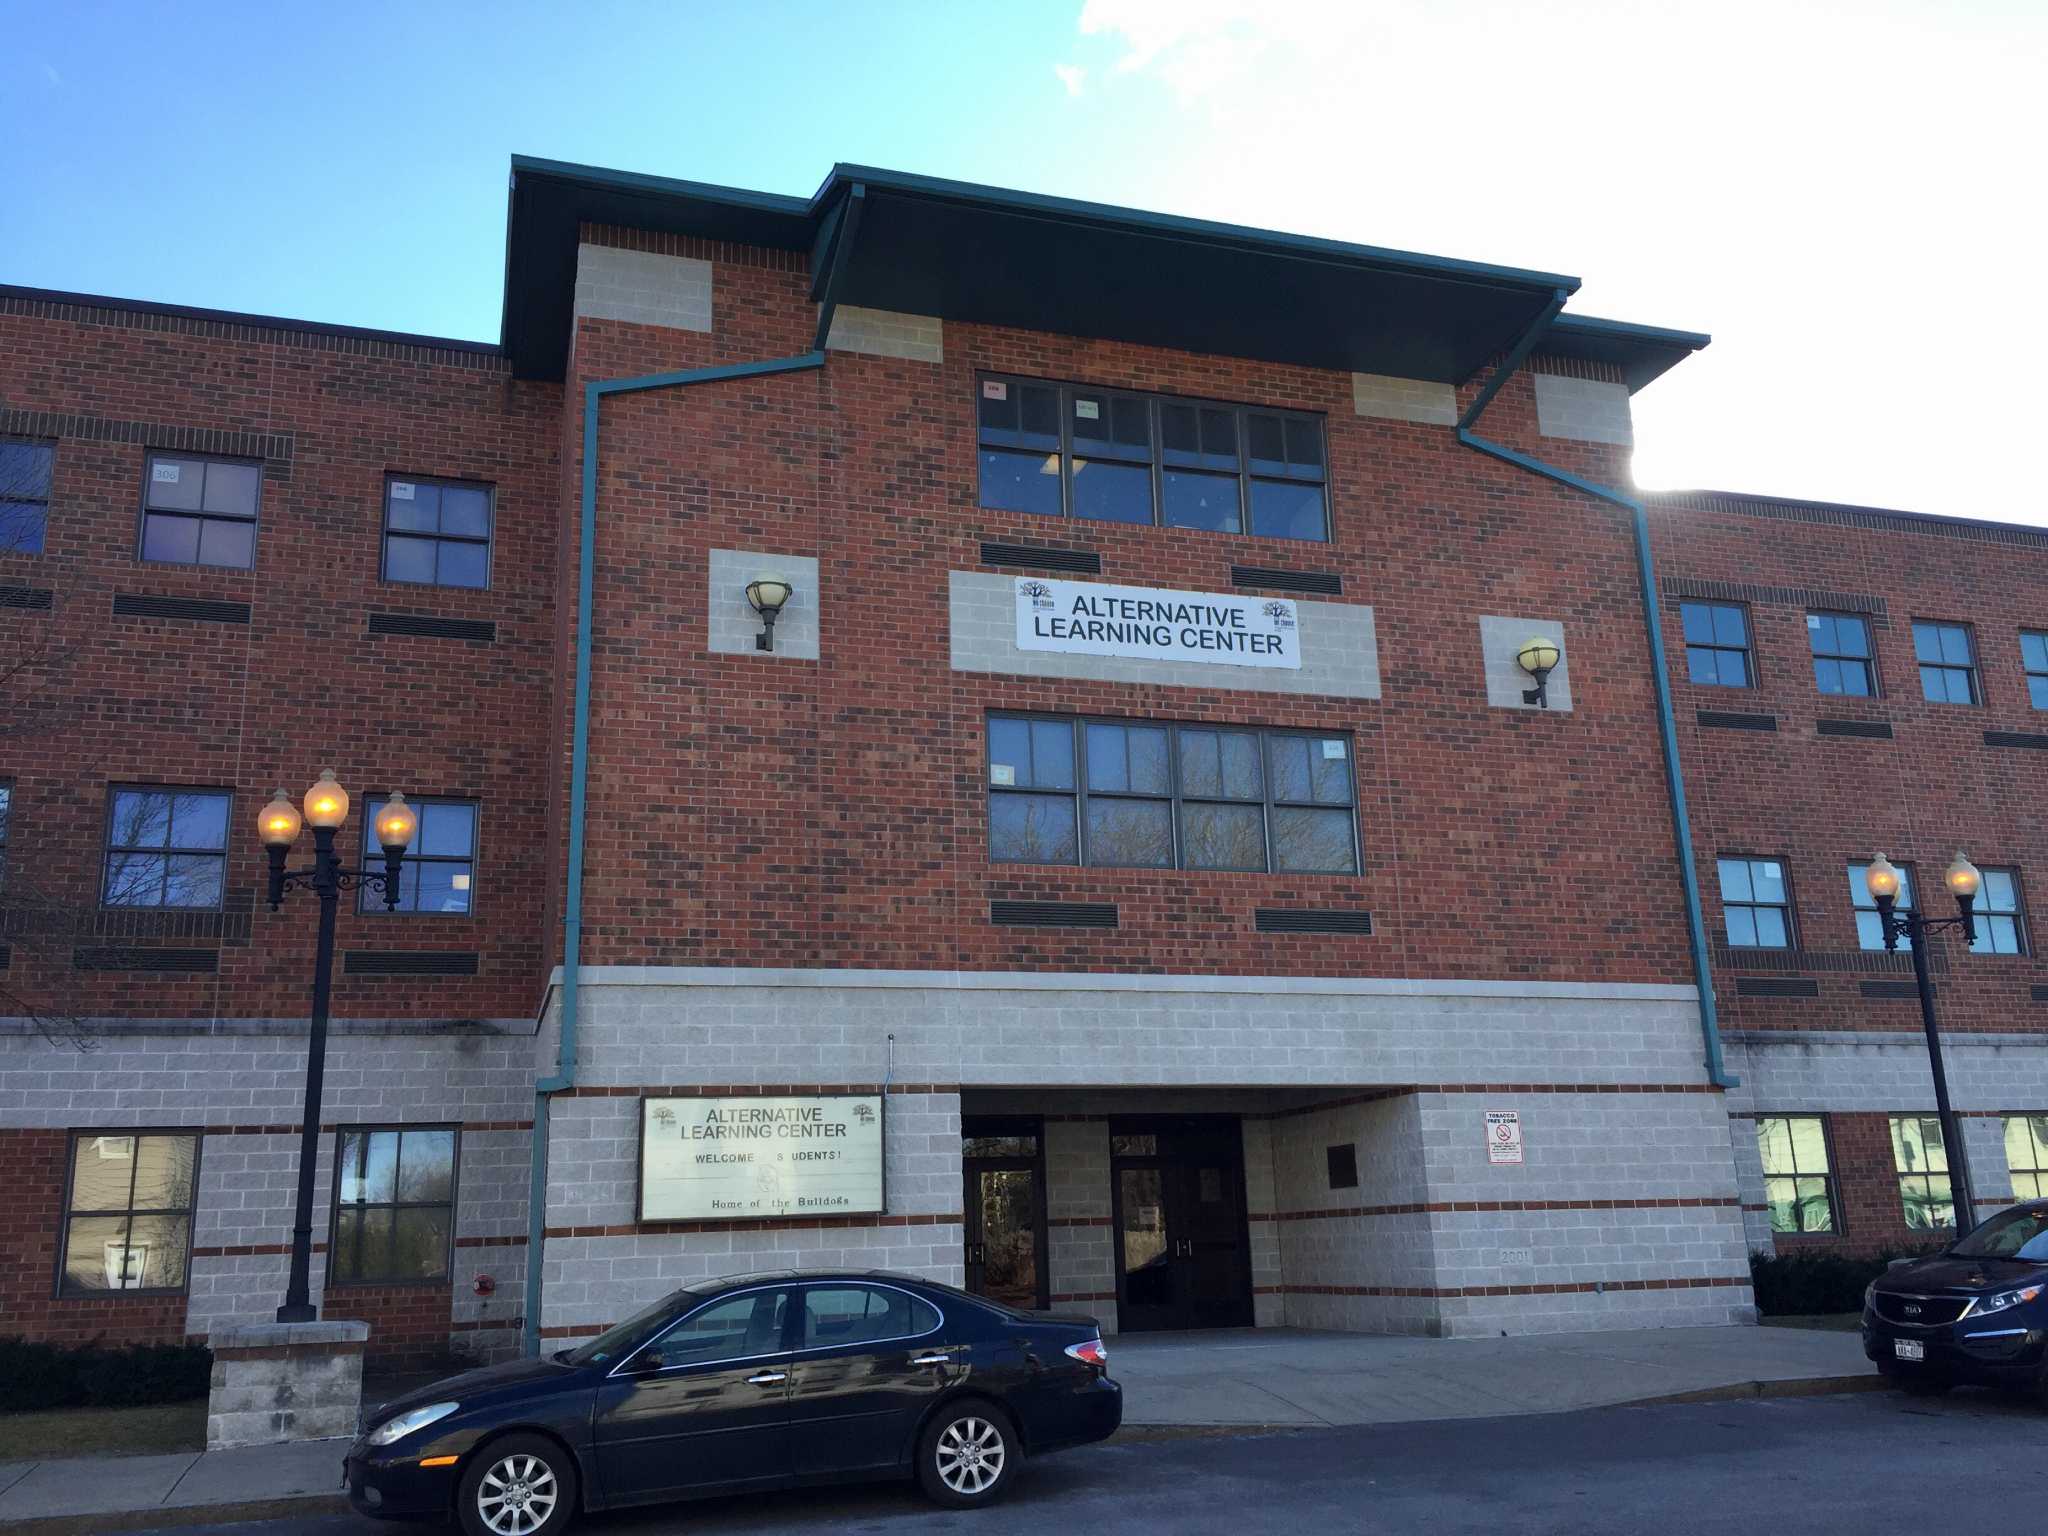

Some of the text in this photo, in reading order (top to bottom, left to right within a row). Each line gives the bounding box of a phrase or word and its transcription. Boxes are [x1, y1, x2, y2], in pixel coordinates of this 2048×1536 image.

[1072, 594, 1246, 629] ALTERNATIVE
[1035, 616, 1284, 655] LEARNING CENTER
[706, 1108, 823, 1124] ALTERNATIVE
[681, 1124, 772, 1140] LEARNING
[777, 1123, 847, 1138] CENTER
[695, 1151, 841, 1163] WELCOME SUDENTS!
[712, 1196, 849, 1209] Home of the Bulldogs
